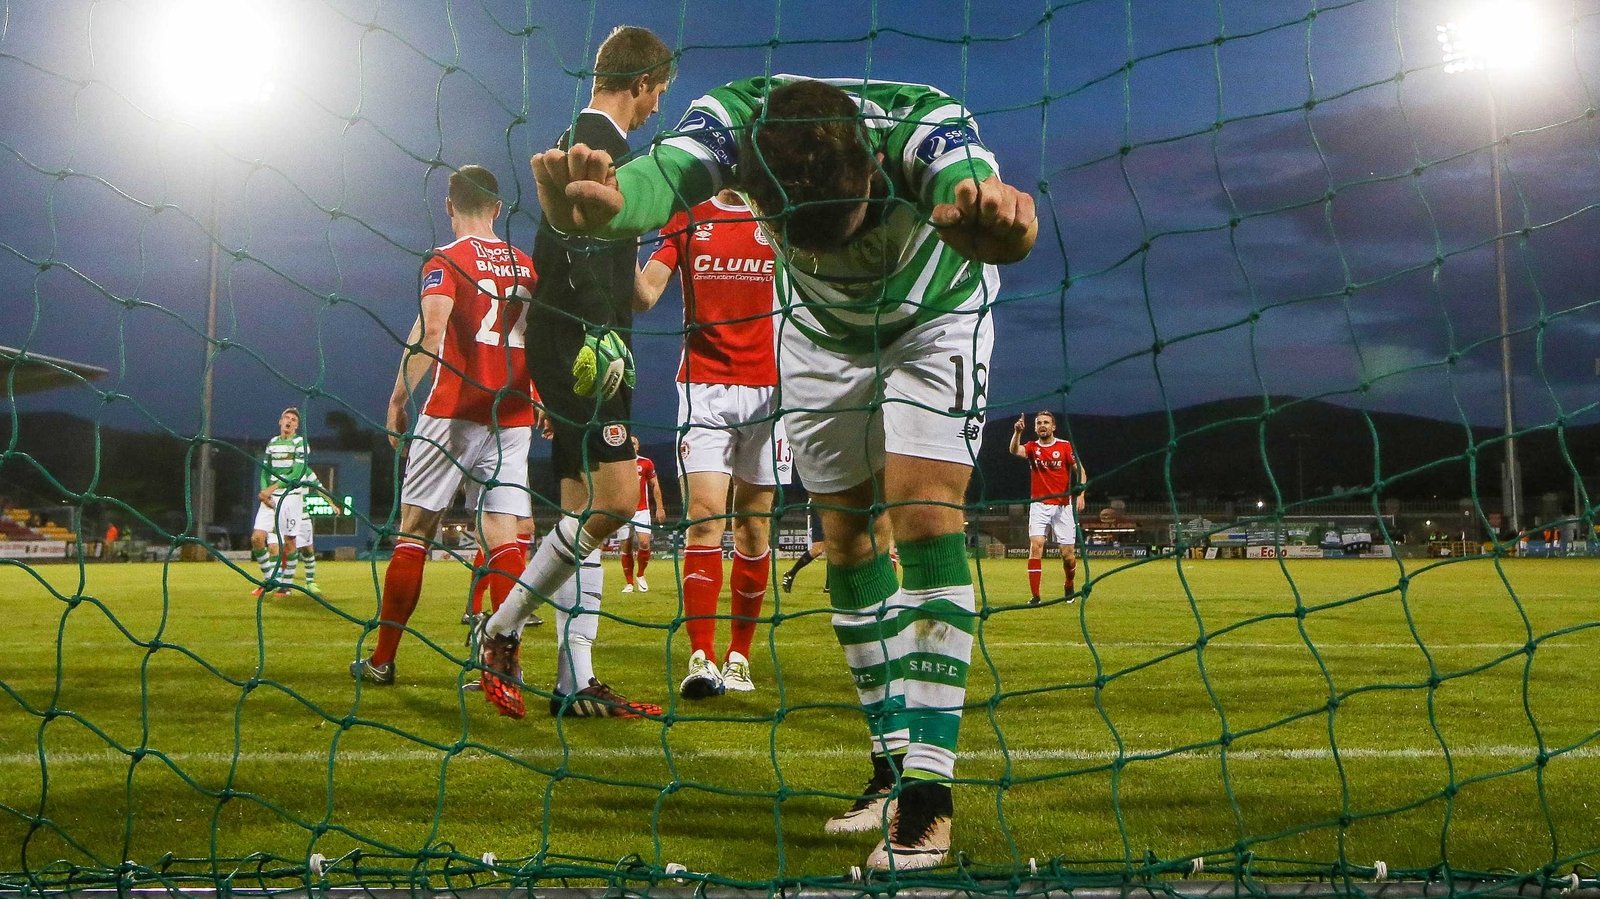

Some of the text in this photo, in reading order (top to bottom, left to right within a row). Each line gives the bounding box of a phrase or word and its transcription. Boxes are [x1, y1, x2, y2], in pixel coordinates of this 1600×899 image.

[476, 260, 531, 277] BARKER
[694, 254, 775, 273] CLUNE
[475, 278, 532, 349] 22
[948, 355, 987, 424] 18
[286, 518, 296, 529] 19
